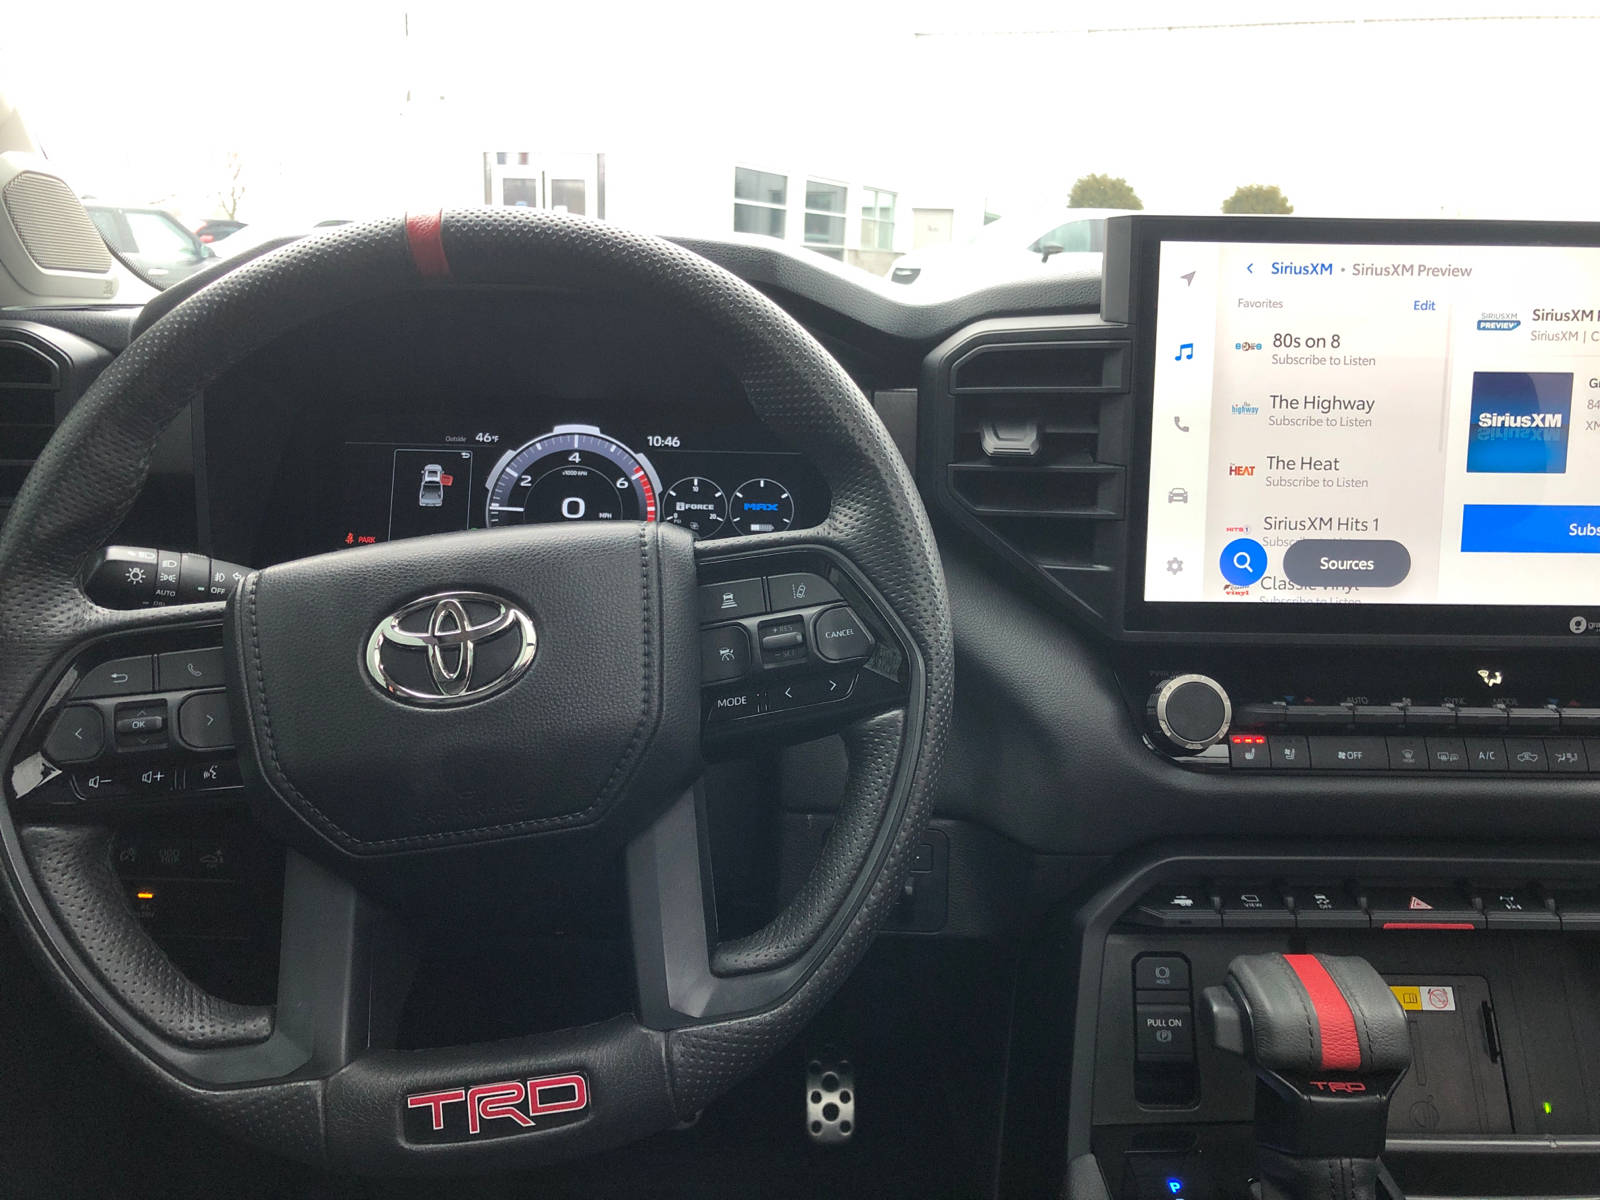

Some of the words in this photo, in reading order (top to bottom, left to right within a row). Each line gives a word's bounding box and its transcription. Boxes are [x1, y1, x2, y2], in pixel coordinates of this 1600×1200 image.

[1271, 262, 1333, 275] SiriusXM
[1352, 263, 1414, 277] SiriusXM
[1418, 264, 1472, 277] Preview
[1237, 298, 1284, 308] Favorites
[1413, 300, 1436, 311] Edit
[1532, 308, 1594, 322] SiriusXM
[1273, 333, 1301, 348] 80s
[1305, 336, 1326, 348] on
[1330, 334, 1341, 349] 8
[1530, 330, 1579, 341] SiriusXM
[1271, 354, 1327, 365] Subscribe
[1329, 356, 1341, 365] to
[1343, 355, 1376, 366] Listen
[1231, 404, 1259, 415] highway
[1269, 395, 1299, 410] The
[1304, 396, 1375, 414] Highway
[1268, 415, 1323, 426] Subscribe
[1326, 417, 1337, 426] to
[1339, 416, 1372, 427] Listen
[1478, 412, 1562, 428] SiriusXM
[445, 435, 467, 443] Outside
[647, 435, 681, 447] 10:46
[568, 452, 581, 463] 4
[1266, 456, 1296, 471] The
[1300, 457, 1340, 471] Heat
[1229, 466, 1255, 476] HEAT
[520, 475, 532, 486] 2
[616, 477, 629, 488] 6
[1265, 476, 1320, 487] Subscribe
[1322, 478, 1334, 487] to
[1336, 477, 1369, 488] Listen
[562, 497, 585, 518] 0
[744, 503, 778, 511] MAX
[1263, 516, 1333, 531] SiriusXM
[1337, 517, 1368, 532] Hits
[1372, 518, 1380, 531] 1
[358, 536, 376, 544] PARK
[1320, 557, 1374, 571] Sources
[155, 589, 176, 597] AUTO
[210, 586, 226, 595] OFF
[825, 628, 855, 639] CANCEL
[717, 696, 748, 708] MODE
[1346, 696, 1369, 705] AUTO
[1444, 697, 1467, 705] SYNC
[1493, 697, 1518, 706] MODE
[132, 720, 146, 729] OK
[1347, 751, 1363, 760] OFF
[1478, 751, 1496, 760] A/C
[1147, 1018, 1166, 1027] PULL
[1168, 1018, 1182, 1027] ON
[1309, 1081, 1366, 1092] TRD
[407, 1075, 587, 1134] TRD
[1169, 1182, 1181, 1193] P
